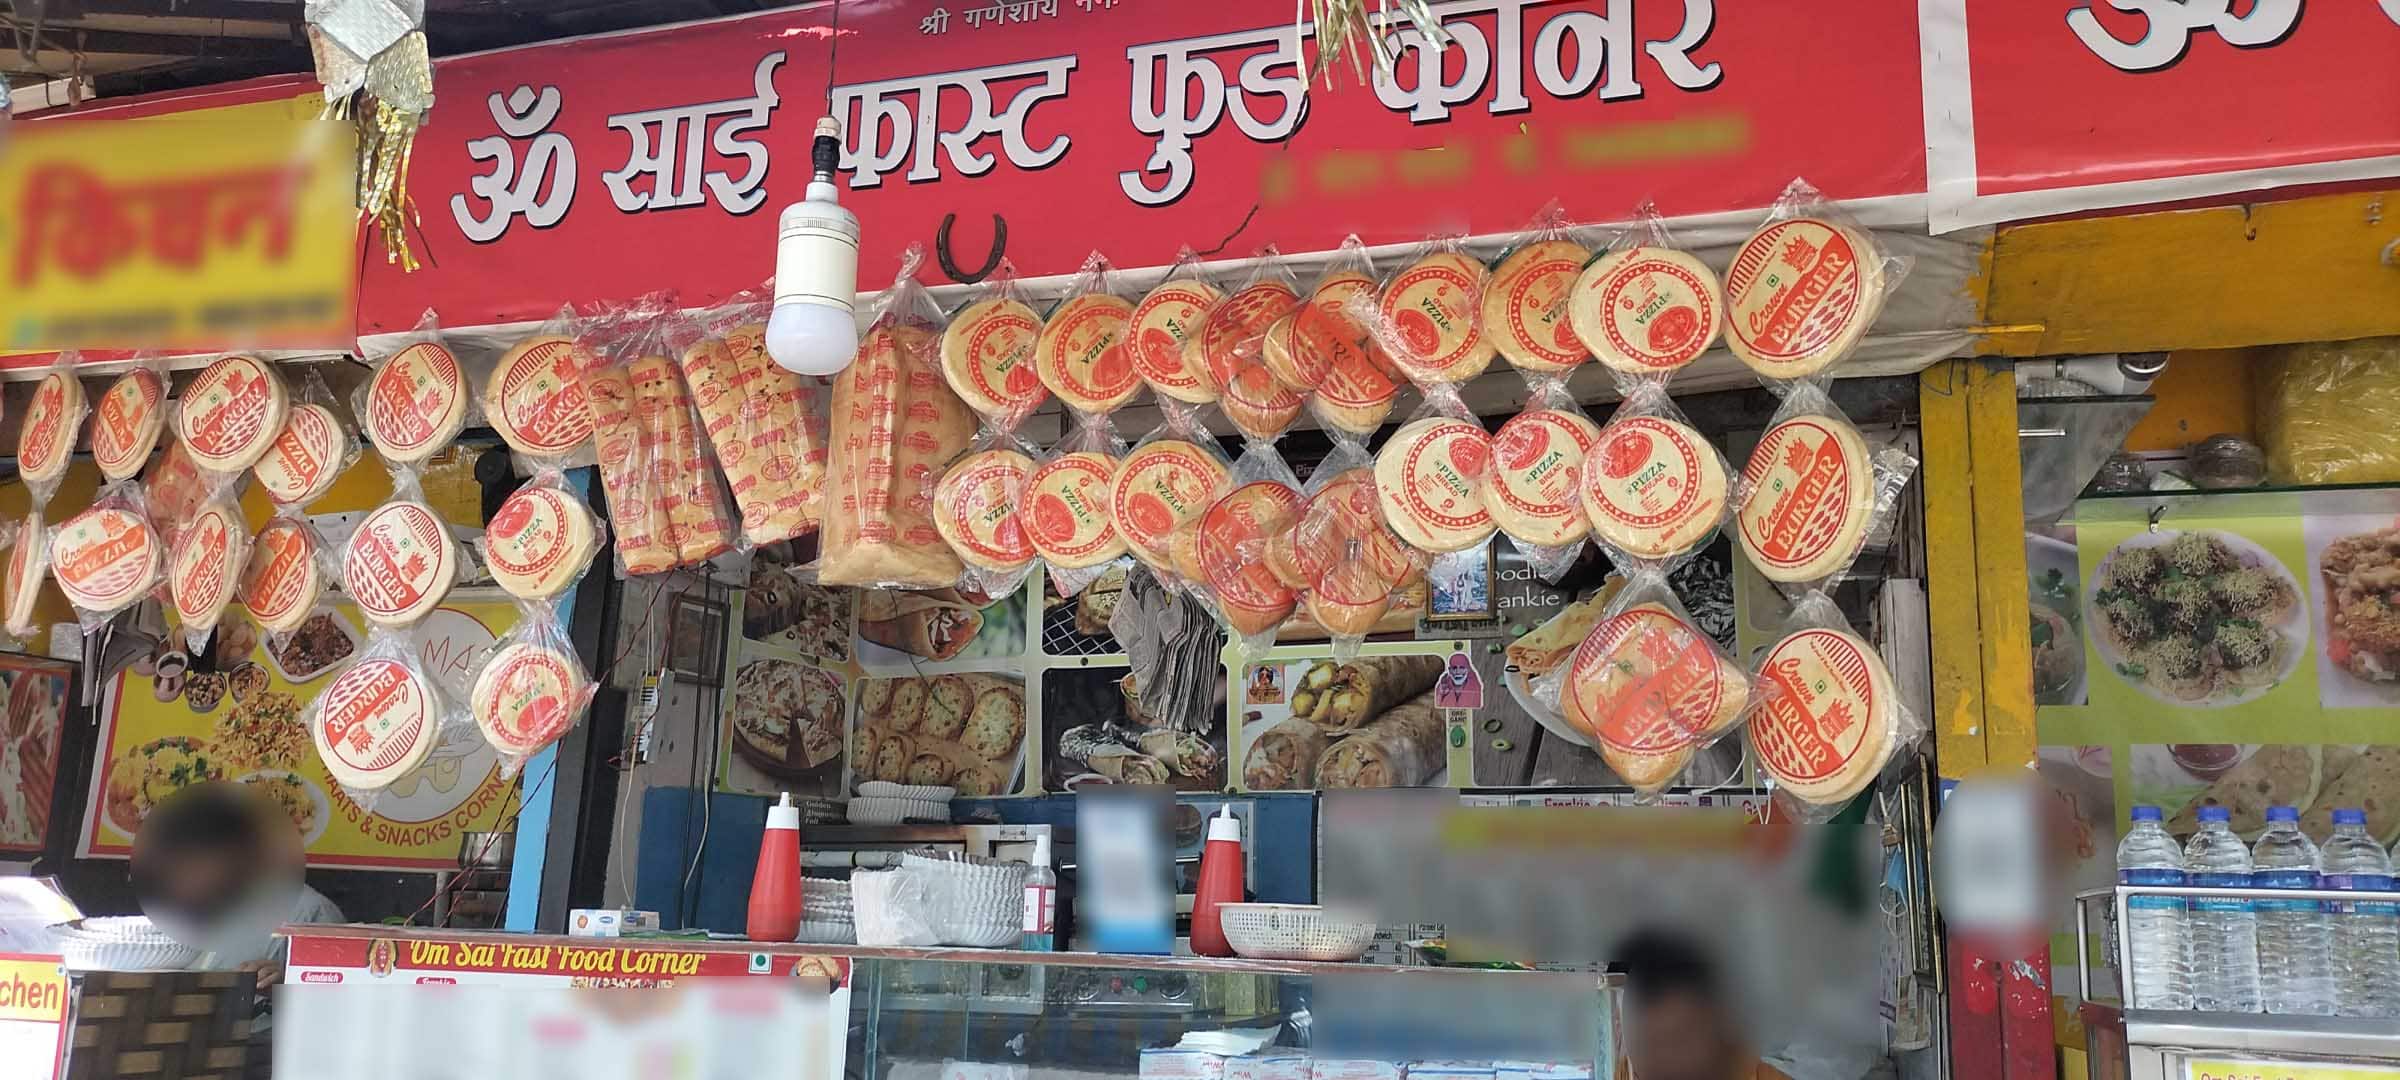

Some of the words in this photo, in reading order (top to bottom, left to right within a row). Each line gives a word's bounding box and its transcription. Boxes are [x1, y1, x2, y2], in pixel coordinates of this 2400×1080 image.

[919, 8, 951, 34] श्री
[450, 85, 577, 243] ॐ
[1422, 297, 1450, 328] PIZZA
[1635, 295, 1667, 325] PIZZA
[1750, 284, 1787, 334] Crown
[1771, 252, 1847, 344] BURGER
[1166, 317, 1184, 339] ZZA
[1080, 336, 1112, 365] PIZZA
[204, 387, 263, 447] BURGER
[533, 391, 585, 437] BURG
[1439, 465, 1470, 498] PIZZA
[1529, 451, 1563, 481] PIZZA
[1539, 463, 1563, 485] BREAD
[1631, 461, 1667, 492] PIZZA
[1061, 485, 1087, 520] PIZZA
[1155, 481, 1183, 514] PIZZA
[1435, 473, 1458, 497] BREAD
[1758, 488, 1791, 540] Crown
[1776, 456, 1838, 550] BURGER
[517, 518, 543, 544] PIZZA
[72, 540, 128, 581] PIZZA
[360, 540, 407, 603] BURGER
[1495, 567, 1538, 581] oodl
[1498, 587, 1560, 608] ankie
[1777, 658, 1815, 705] Crown
[332, 670, 395, 734] BURGER
[1774, 696, 1828, 769] URGER
[360, 816, 372, 836] &
[376, 821, 451, 847] SNACKS
[455, 766, 507, 829] CORN
[411, 940, 449, 966] Om
[455, 942, 495, 968] Sai
[501, 944, 550, 969] Fast
[557, 947, 615, 972] Food
[622, 949, 706, 975] Corner
